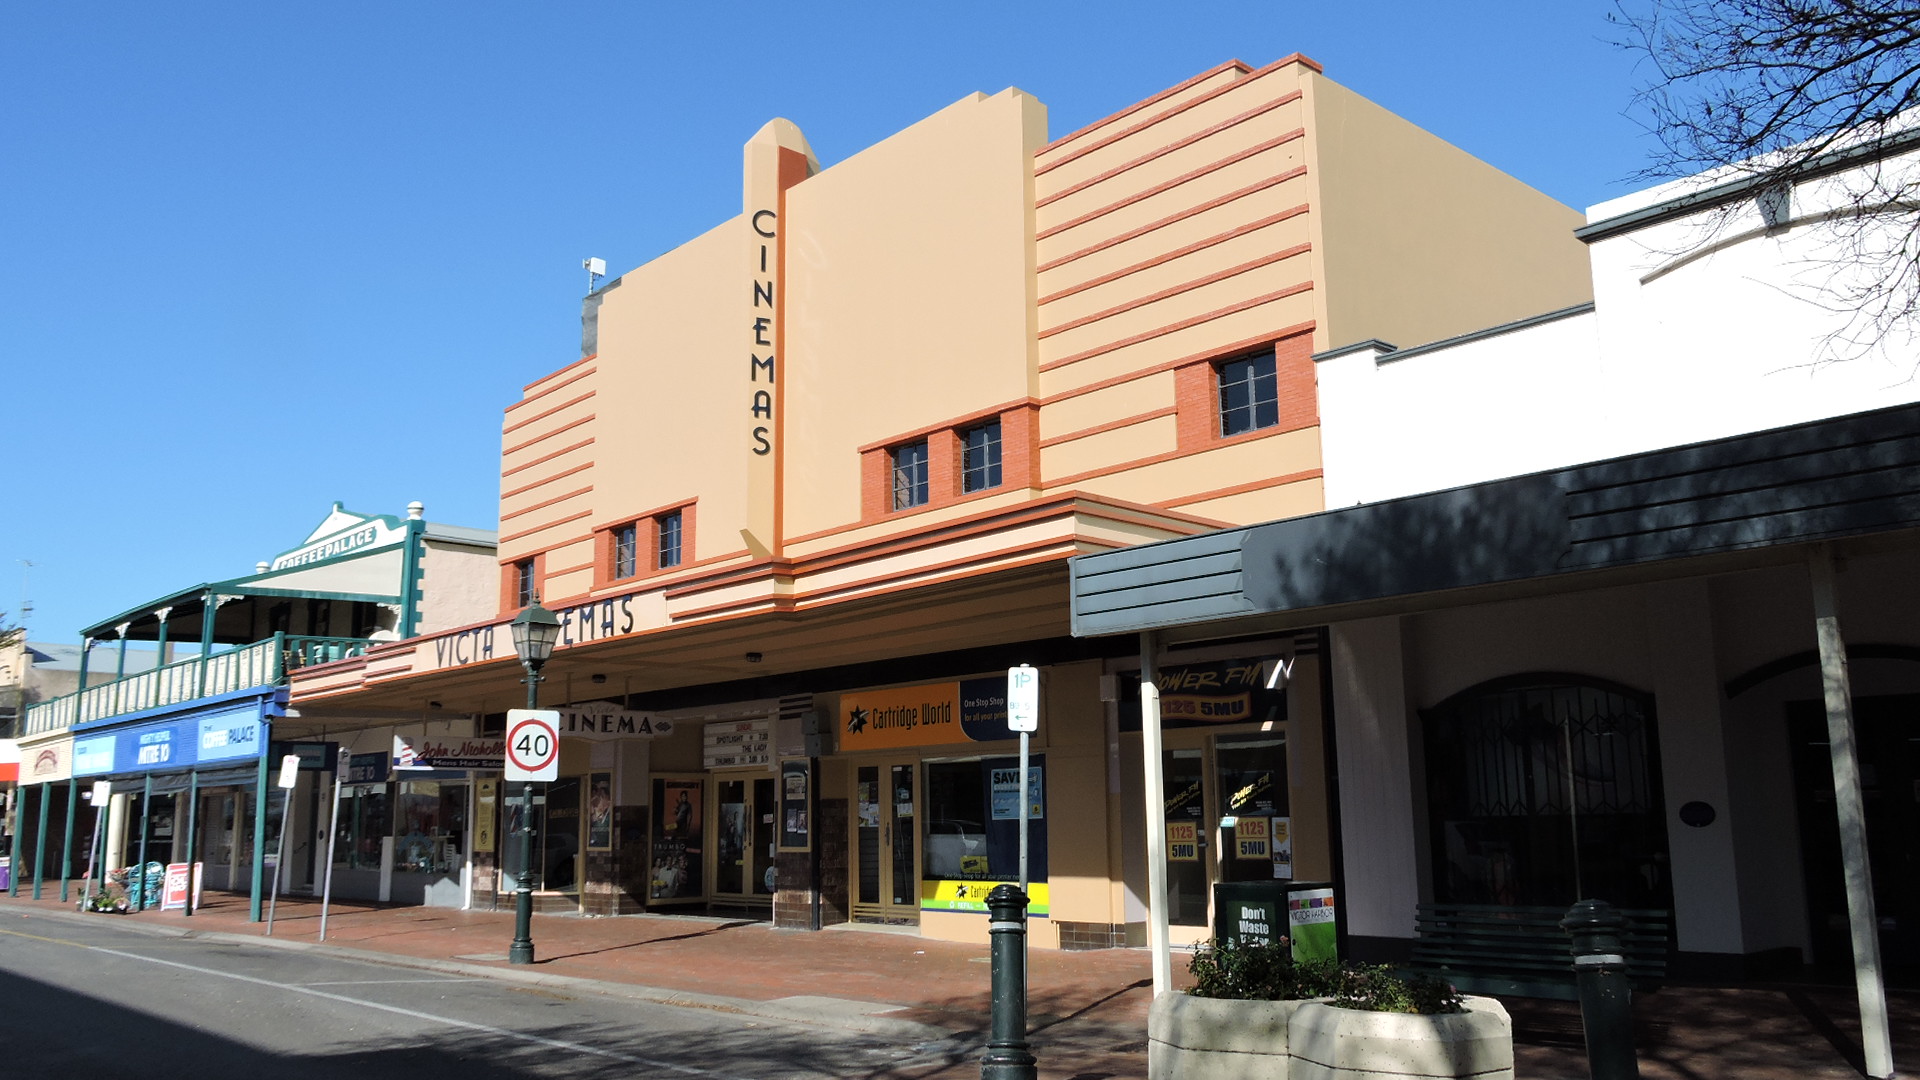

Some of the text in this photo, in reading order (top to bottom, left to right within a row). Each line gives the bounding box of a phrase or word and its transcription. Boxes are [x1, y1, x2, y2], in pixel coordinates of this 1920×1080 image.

[751, 209, 777, 456] CINEMAS
[436, 594, 635, 668] VICTA EMAS
[1225, 660, 1264, 686] FM
[964, 696, 1004, 709] One Stop Shop
[1159, 699, 1244, 716] 125 5MU
[872, 701, 951, 731] Cartridge World
[964, 711, 1007, 723] for all your print
[228, 726, 255, 745] PALACE
[415, 741, 448, 761] John
[515, 735, 549, 757] 40
[1170, 826, 1193, 839] 1125
[1239, 821, 1264, 835] 1125
[1171, 844, 1194, 858] 5MU
[1240, 841, 1265, 855] 5MU
[970, 885, 994, 898] Cartrid
[1241, 906, 1266, 920] Don't
[1239, 920, 1270, 935] Waste
